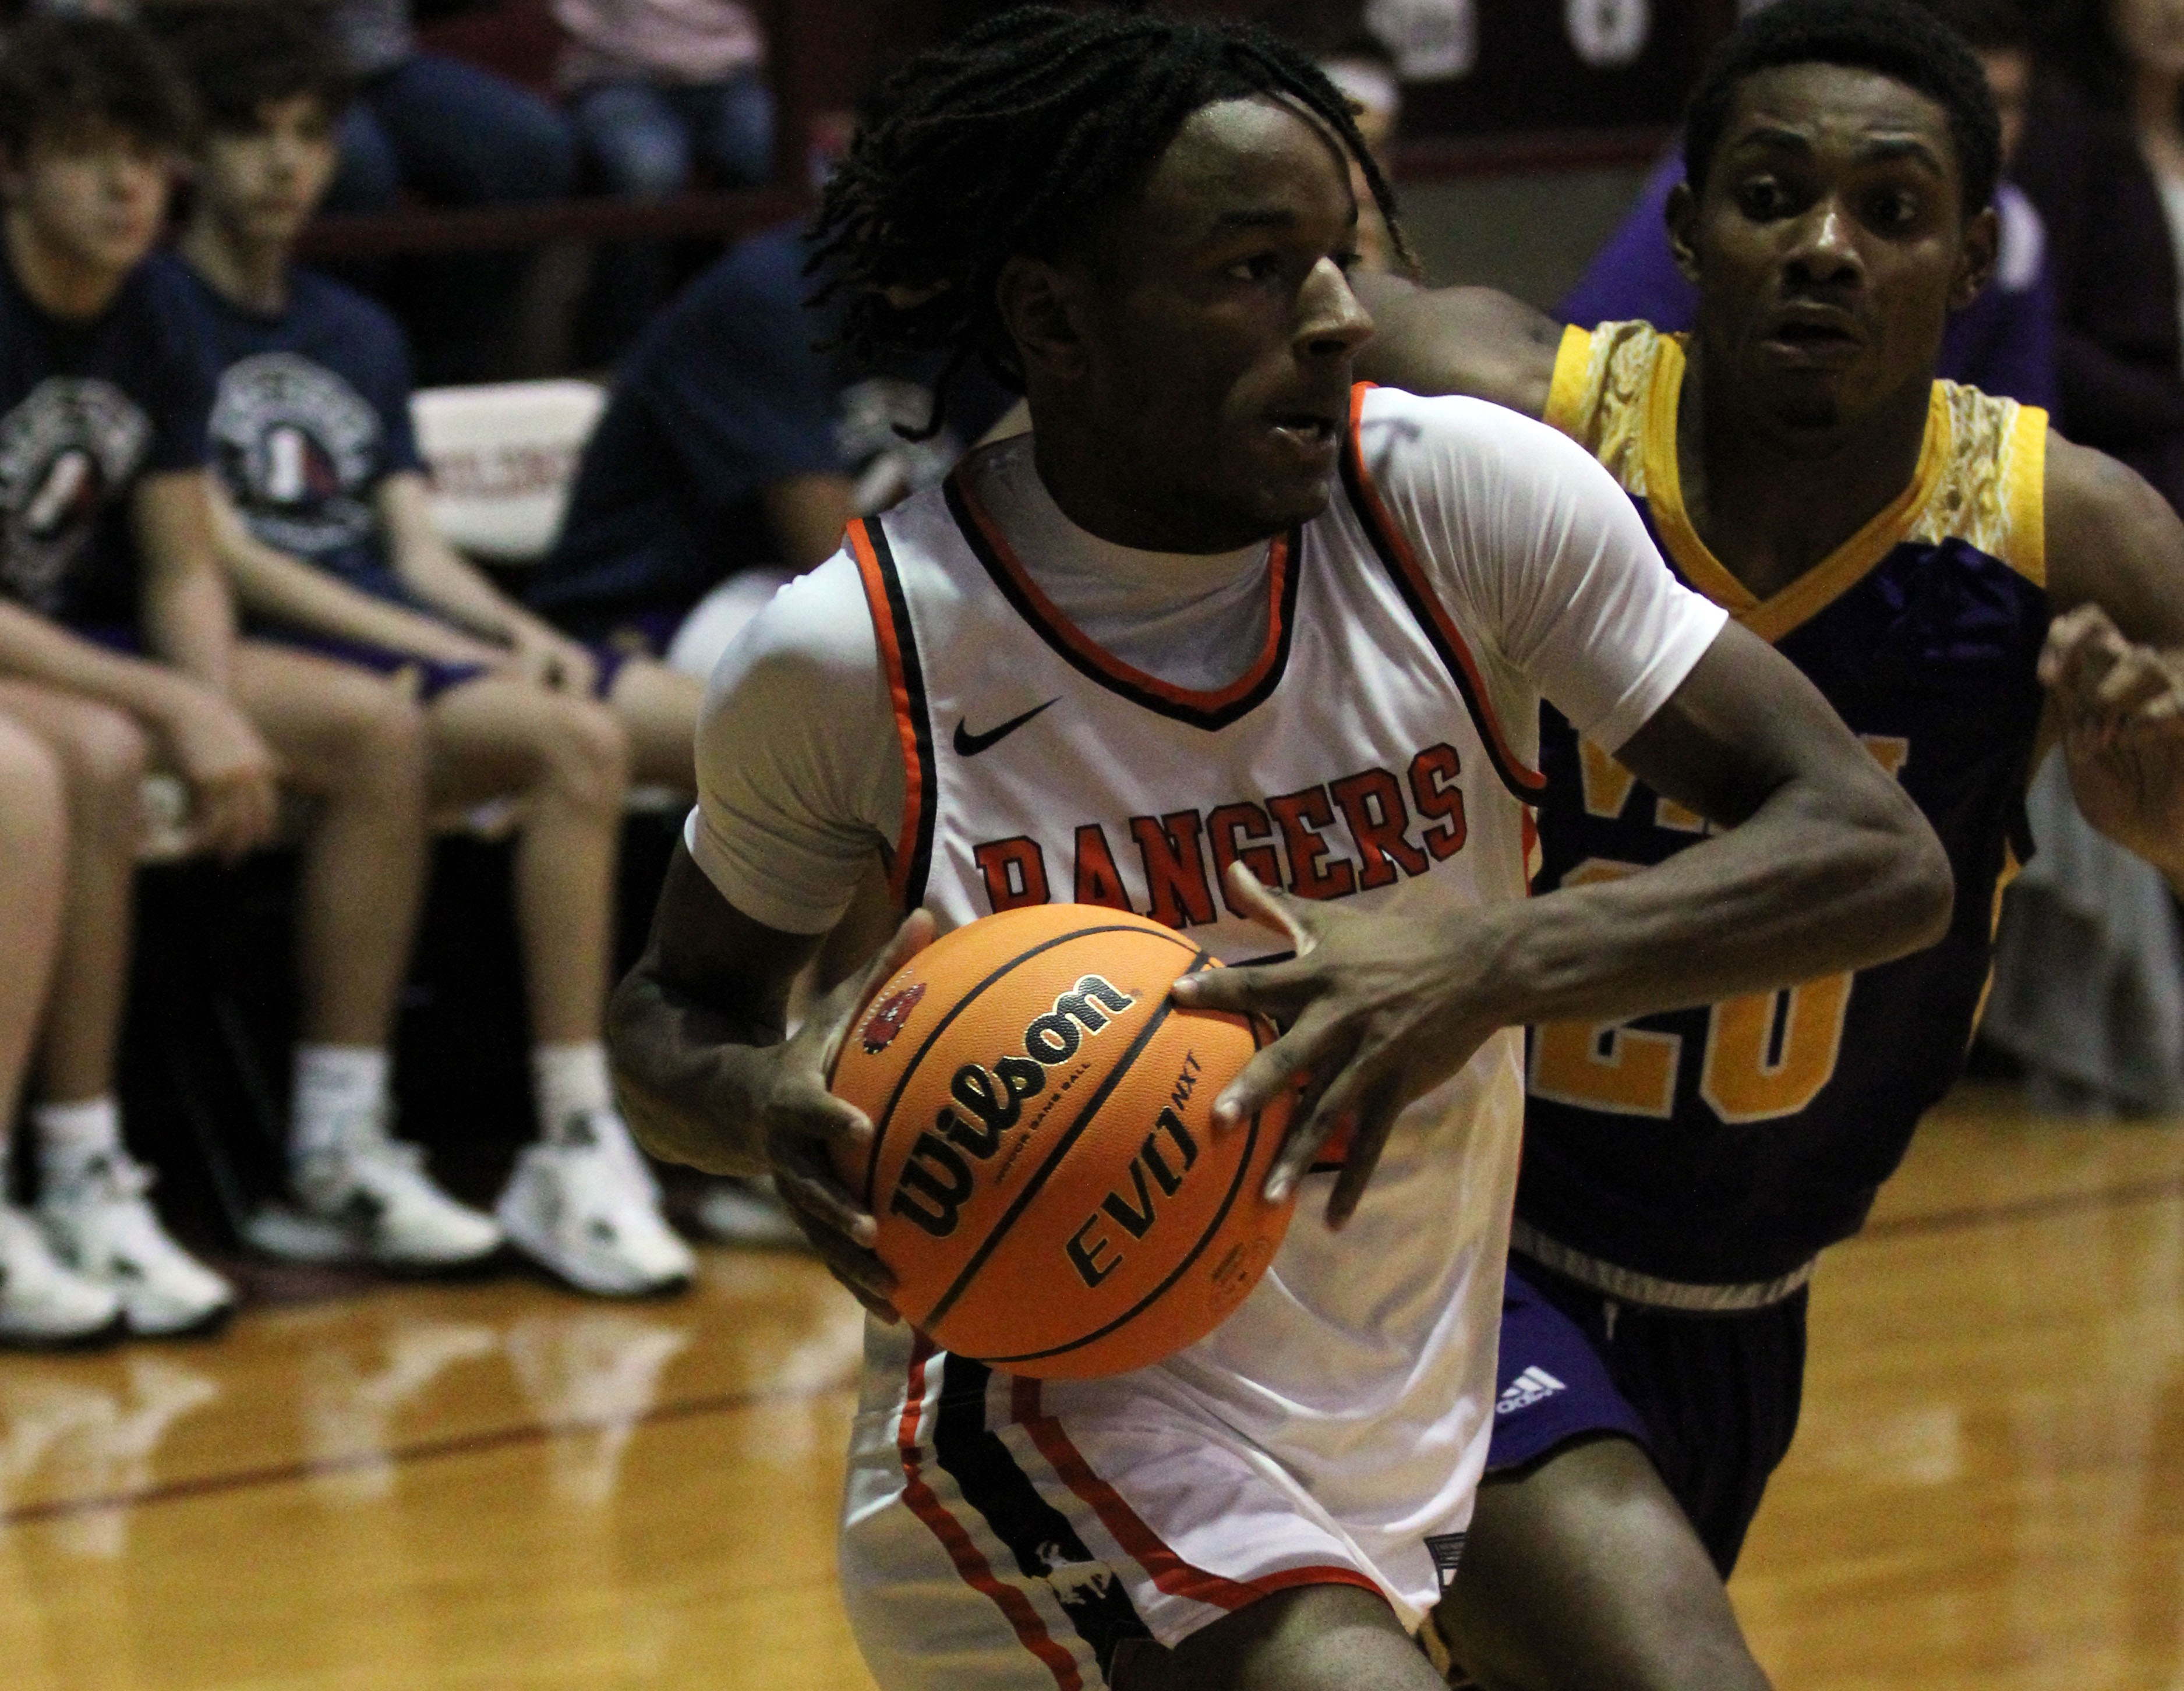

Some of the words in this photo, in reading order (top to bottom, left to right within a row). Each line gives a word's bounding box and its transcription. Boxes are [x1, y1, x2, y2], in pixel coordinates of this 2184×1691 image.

[972, 742, 1467, 930] RANGERS
[889, 974, 1137, 1238] Wilson
[1030, 1092, 1061, 1130] GAME
[1061, 1063, 1091, 1091] BALL
[1526, 857, 1854, 1124] 20
[1065, 1105, 1199, 1288] EVO
[1171, 1049, 1201, 1111] NXT
